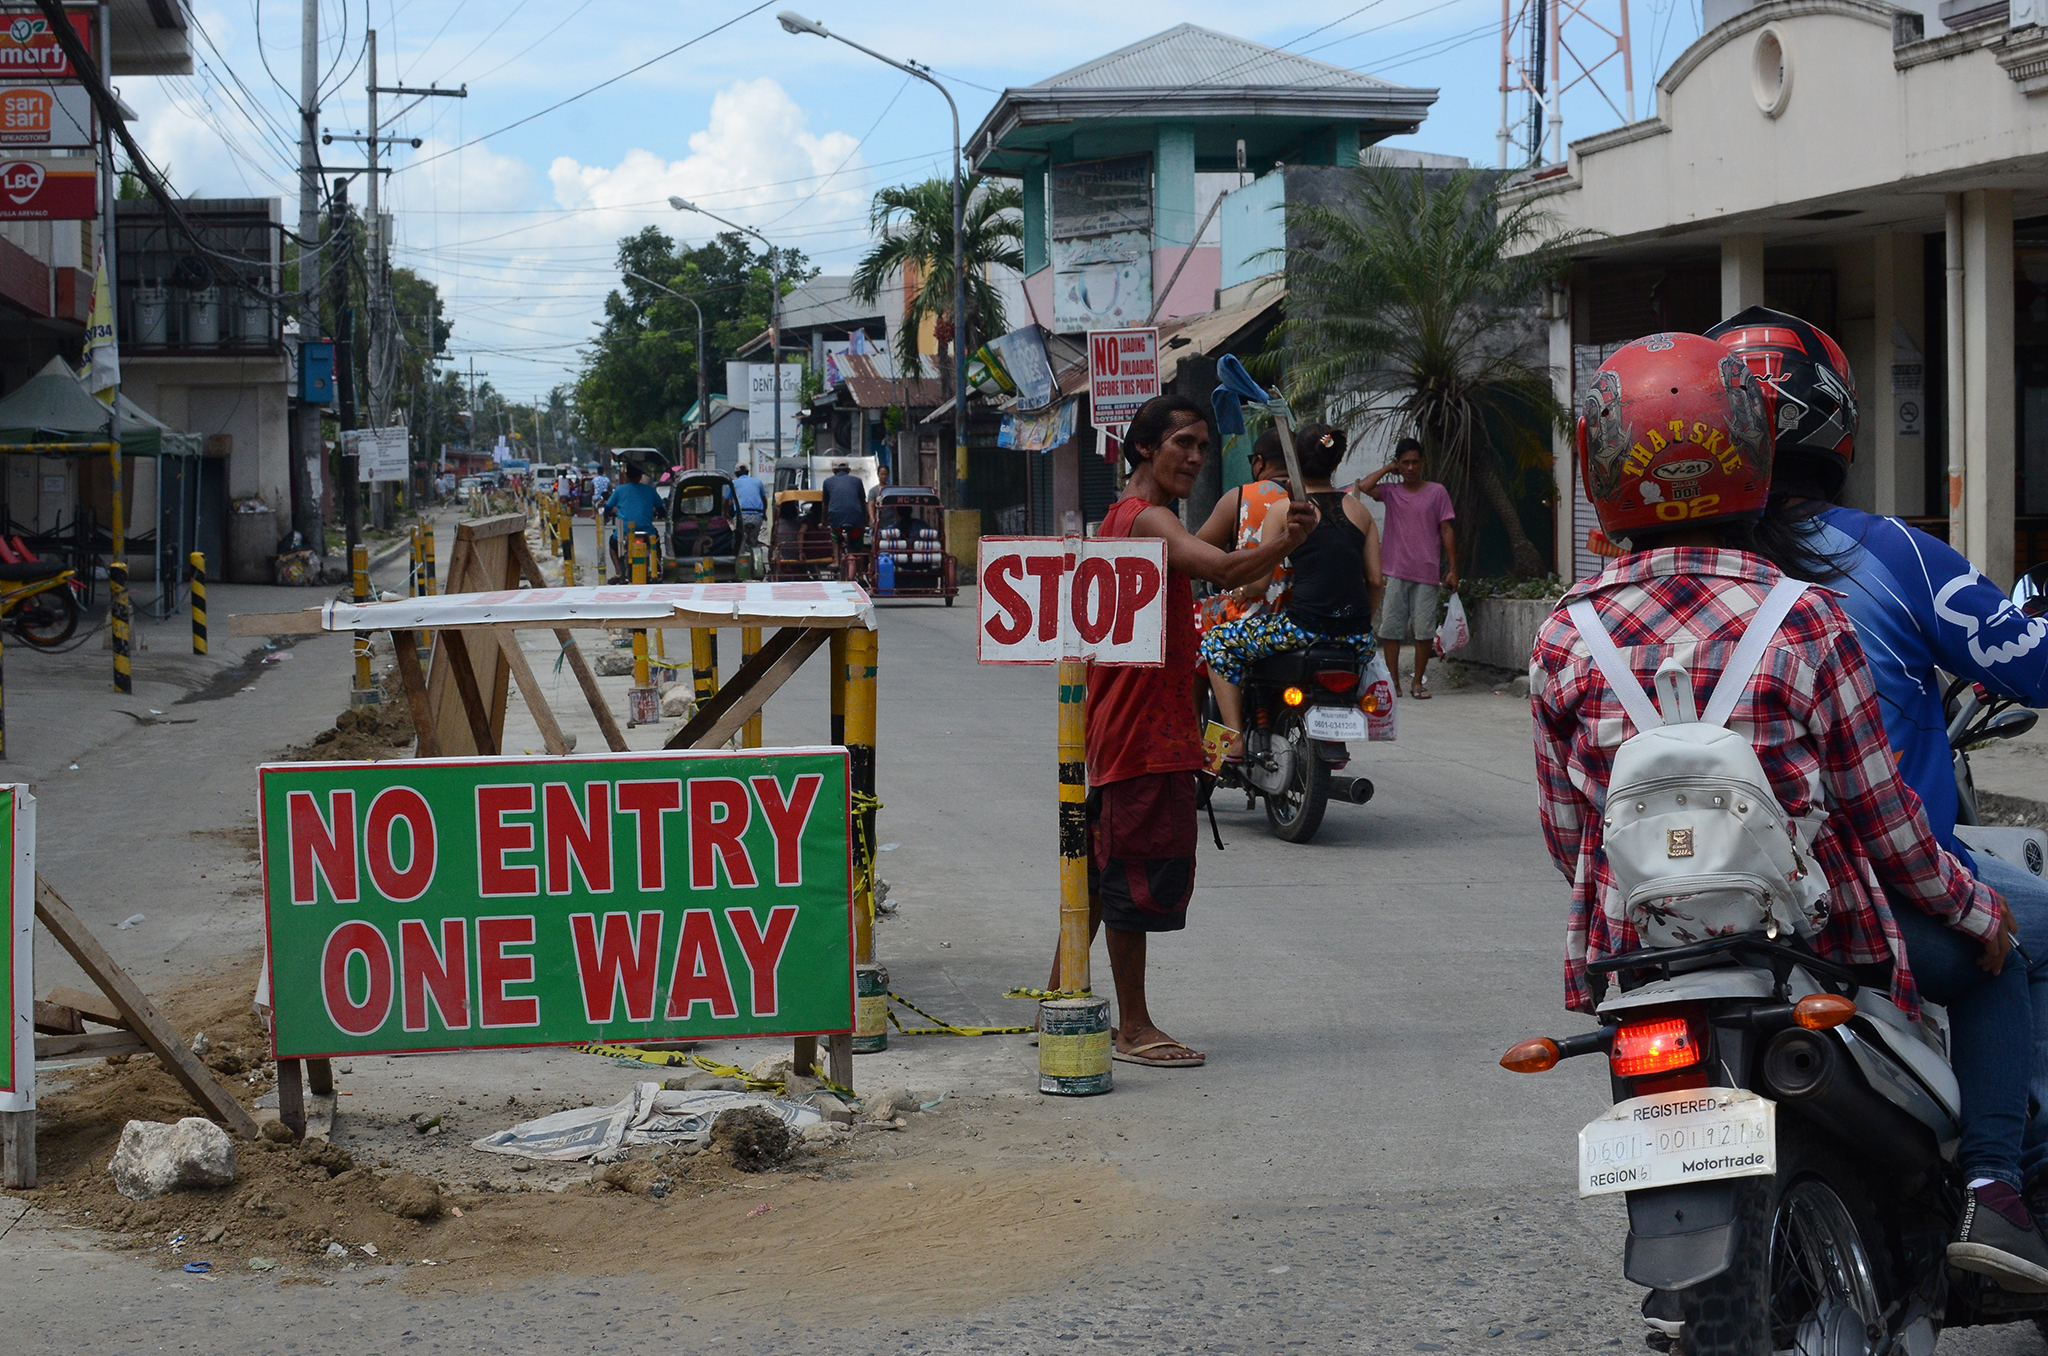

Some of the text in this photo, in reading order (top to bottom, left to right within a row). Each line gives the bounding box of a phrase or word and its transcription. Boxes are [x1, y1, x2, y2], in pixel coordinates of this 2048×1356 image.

[5, 97, 43, 111] sari
[5, 112, 44, 127] sari
[4, 174, 39, 189] LBC
[1094, 336, 1146, 377] NO LOADING
[1121, 359, 1155, 376] UNLOADING
[1096, 378, 1155, 397] BEFORE THIS POINT
[1672, 486, 1701, 500] DOT
[1655, 494, 1720, 521] 02
[983, 552, 1161, 646] STOP
[286, 772, 825, 906] NO ENTRY
[320, 904, 801, 1036] ONE WAY
[1633, 1098, 1717, 1122] REGISTERED
[1681, 1152, 1765, 1174] Motortrade
[1589, 1168, 1637, 1187] REGION
